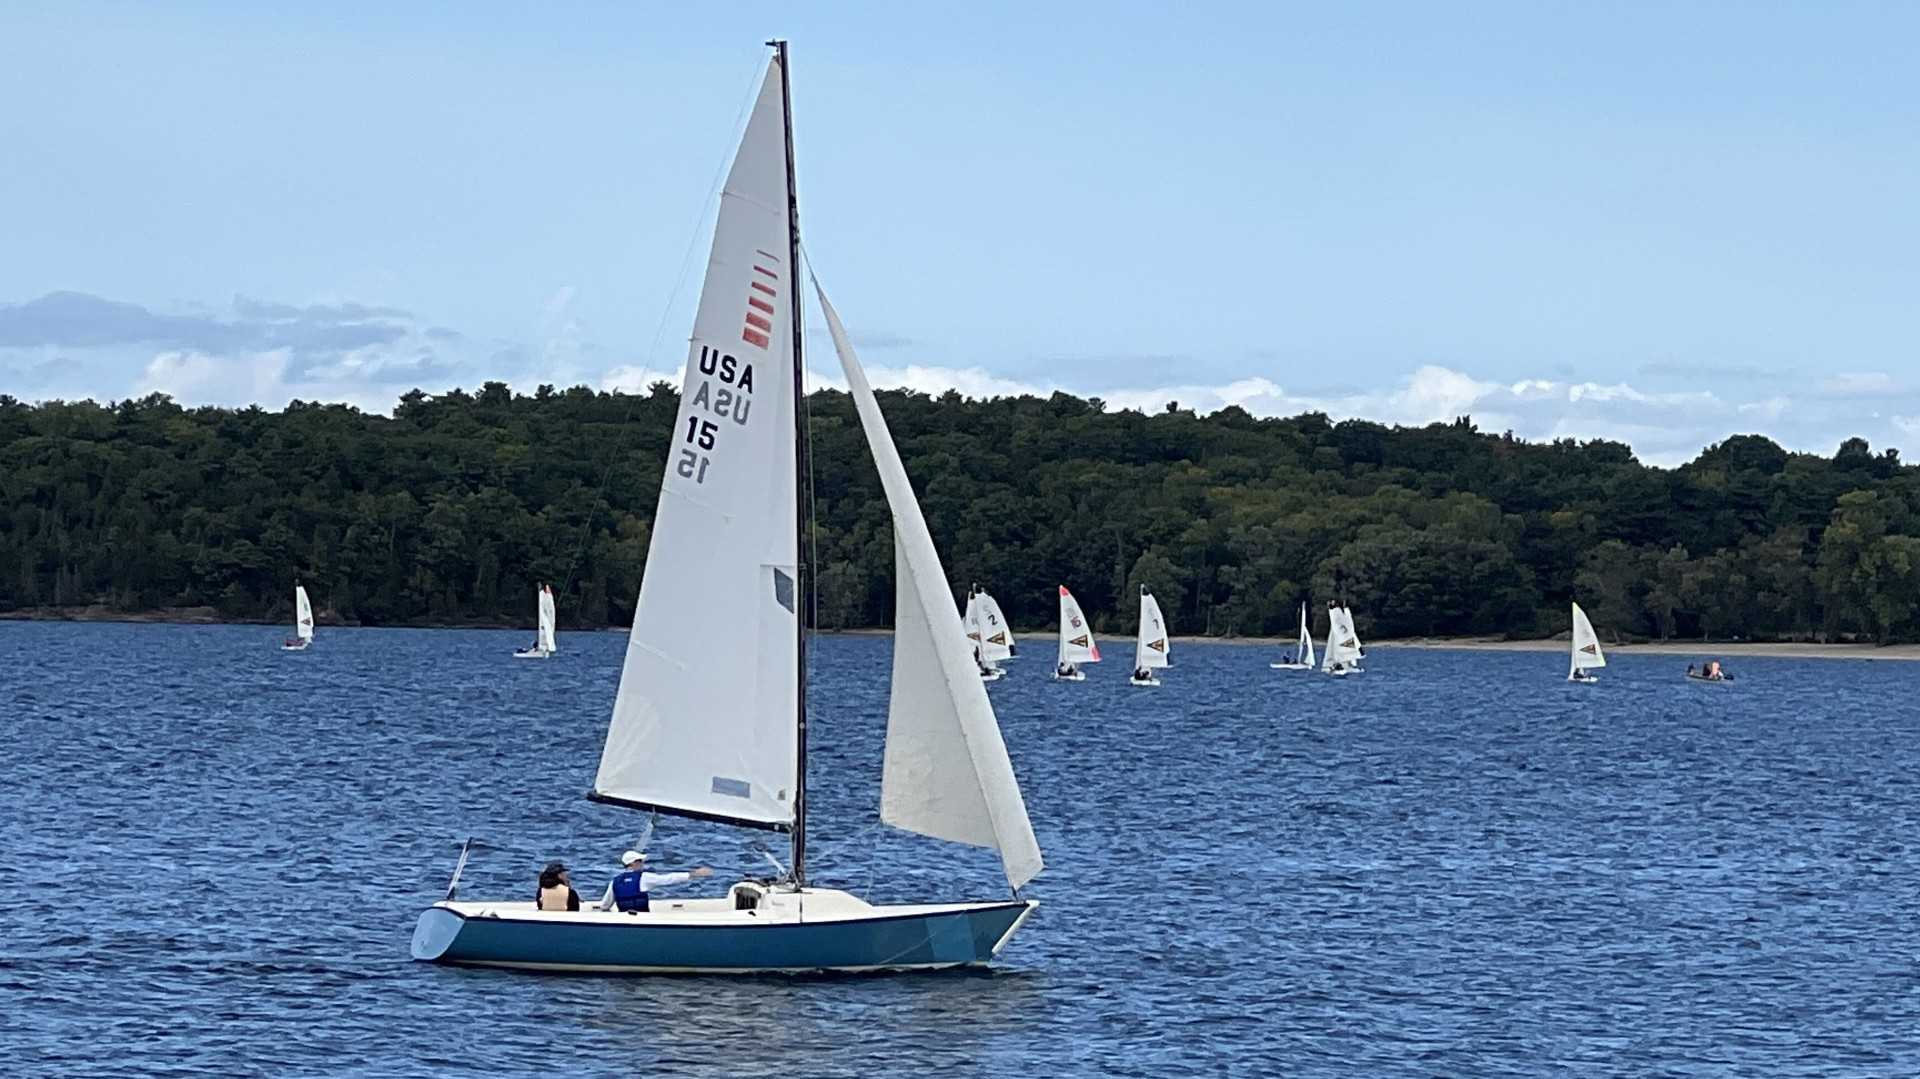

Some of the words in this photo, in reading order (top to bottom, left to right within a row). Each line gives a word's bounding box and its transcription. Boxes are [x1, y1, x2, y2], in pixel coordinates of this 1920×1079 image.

[699, 345, 754, 394] USA
[686, 415, 719, 450] 15
[988, 614, 998, 625] 2
